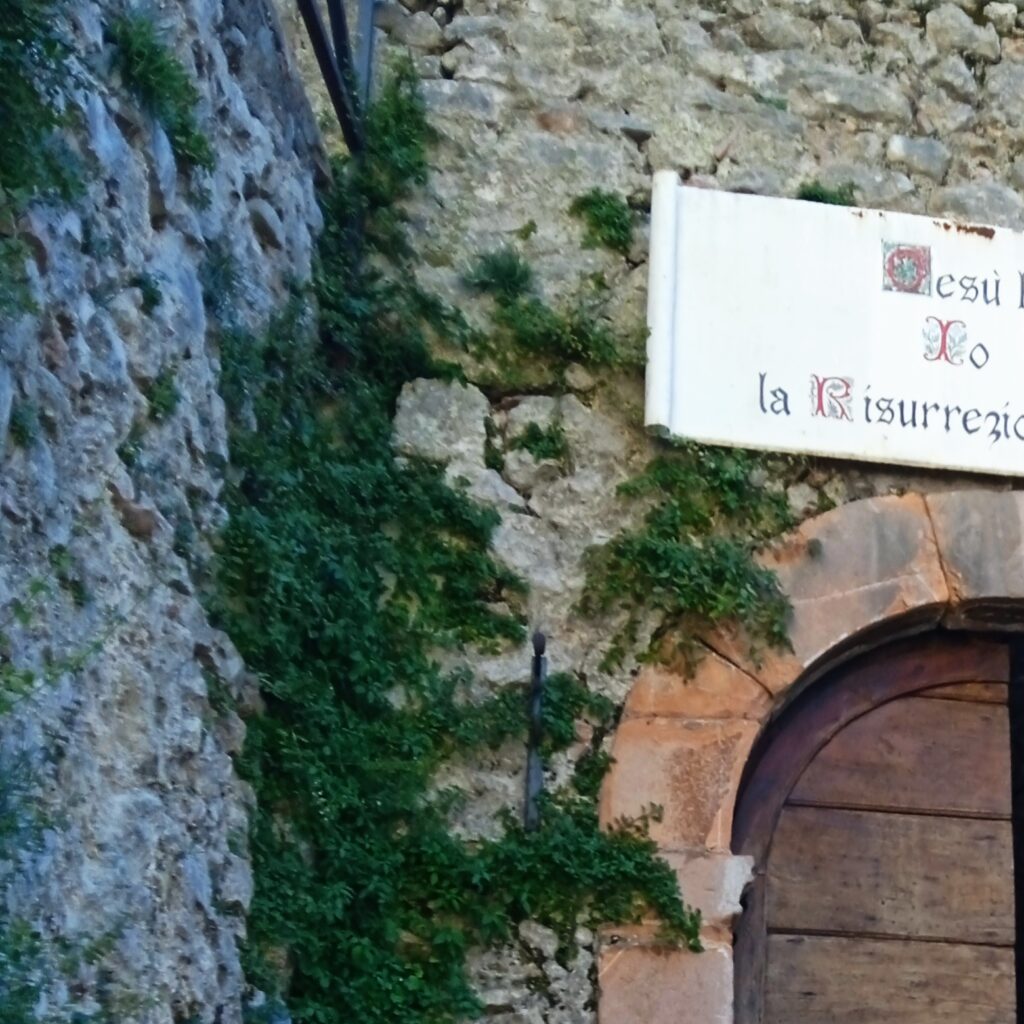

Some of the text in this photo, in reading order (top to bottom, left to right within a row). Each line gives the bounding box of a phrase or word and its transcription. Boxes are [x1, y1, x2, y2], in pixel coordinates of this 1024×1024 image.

[882, 240, 1001, 307] Gesù
[922, 316, 989, 369] Io
[758, 372, 791, 416] la
